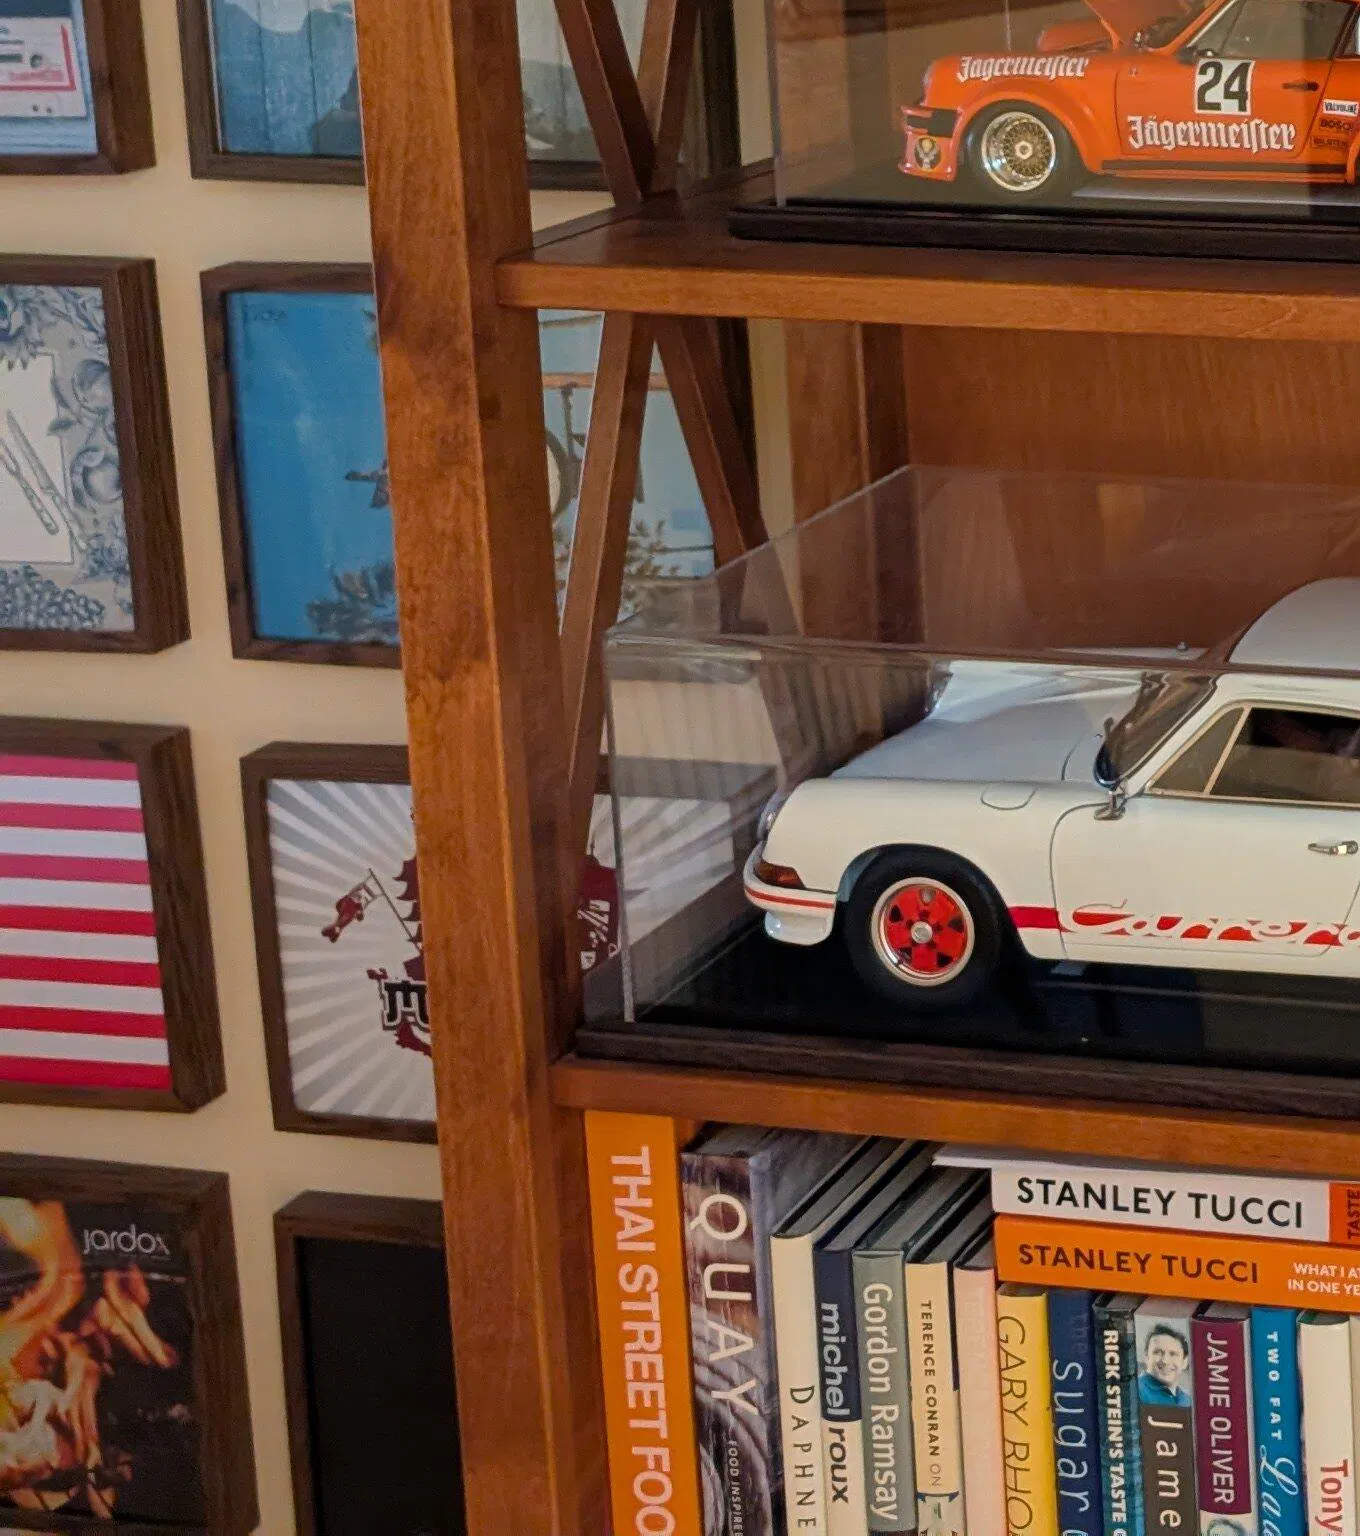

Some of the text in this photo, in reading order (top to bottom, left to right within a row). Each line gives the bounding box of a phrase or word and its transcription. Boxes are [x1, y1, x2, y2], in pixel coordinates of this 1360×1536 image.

[1197, 61, 1251, 111] 24
[611, 1146, 654, 1252] THAI
[1016, 1177, 1303, 1229] STANLEY TUCCI
[1347, 1188, 1360, 1240] TASTE
[689, 1193, 758, 1416] QUAY
[1018, 1244, 1259, 1284] STANLEY TUCCI
[1288, 1279, 1303, 1293] IN
[1307, 1280, 1341, 1296] ONE
[1292, 1262, 1336, 1279] WHAT
[618, 1262, 668, 1440] STREET
[820, 1302, 850, 1504] michel roux
[863, 1282, 899, 1520] Gordon Ramsay
[920, 1300, 942, 1487] TERENCE CONRAN ON
[997, 1315, 1029, 1426] GARY
[1266, 1331, 1283, 1441] TWO FAT
[789, 1385, 817, 1529] DAPHNE
[1104, 1329, 1127, 1523] RICK STEIN'S TASTE
[1148, 1416, 1184, 1528] Jame
[1206, 1332, 1236, 1504] JAMIE OLIVER
[1314, 1458, 1350, 1534] Tony
